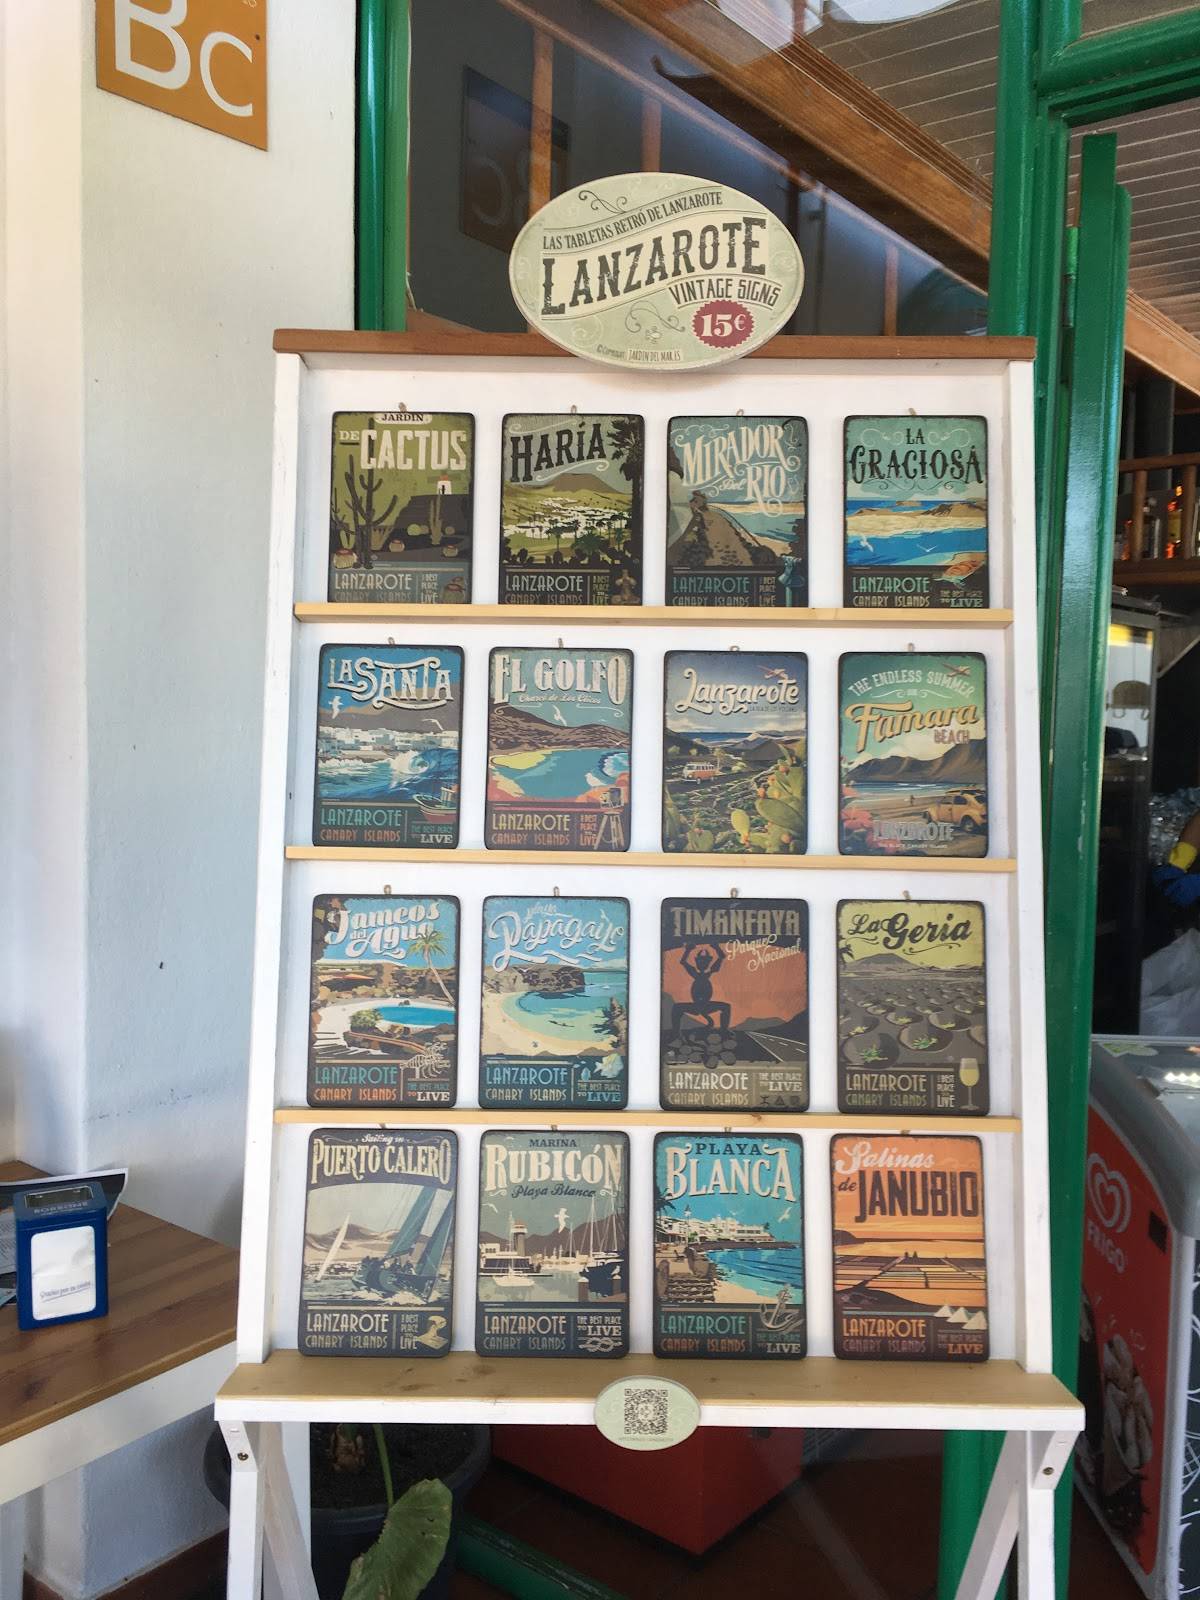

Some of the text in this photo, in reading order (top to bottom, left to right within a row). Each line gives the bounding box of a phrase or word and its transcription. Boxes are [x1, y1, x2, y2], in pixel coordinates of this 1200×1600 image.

[543, 191, 723, 250] LAS TABLETAS RETRÓ DE LANZAROTE
[541, 216, 768, 316] LANZAROTE
[668, 277, 782, 305] VINTAGE SIGNS
[700, 312, 747, 338] 15€
[381, 413, 424, 422] JARDIN
[906, 428, 926, 444] LA
[339, 429, 467, 470] DE CACTUS
[510, 421, 607, 483] HARÍA
[675, 424, 801, 486] MIRADOR
[335, 574, 413, 590] LANZAROTE
[505, 575, 583, 591] LANZAROTE
[673, 577, 750, 593] LANZAROTE
[852, 577, 930, 593] LANZAROTE
[853, 595, 889, 606] CANARY
[895, 596, 930, 607] ISLANDS
[950, 598, 983, 607] LIVE
[328, 656, 454, 710] LA SANTA
[494, 654, 627, 705] EL GOLFO
[848, 669, 975, 698] THE ENDLESS SUMMER
[675, 668, 800, 715] Lanzarote
[845, 700, 980, 753] Famara
[934, 729, 970, 745] BEACH
[320, 808, 402, 826] LANZAROTE
[492, 814, 571, 831] LANZAROTE
[320, 829, 401, 842] CANARY ISLANDS
[420, 834, 453, 843] LIVE
[492, 833, 570, 846] CANARY ISLANDS
[324, 902, 441, 945] Jameos
[848, 912, 973, 950] La Geria
[346, 923, 436, 959] Agua
[488, 911, 624, 972] Papagayo
[725, 934, 777, 961] Parque
[748, 937, 801, 971] Nacional
[315, 1066, 398, 1085] LANZAROTE
[486, 1067, 568, 1085] LANZAROTE
[668, 1072, 749, 1090] LANZAROTE
[846, 1074, 927, 1091] LANZAROTE
[313, 1088, 397, 1101] CANARY ISLANDS
[485, 1088, 567, 1101] CANARY ISLANDS
[768, 1082, 802, 1091] LIVE
[417, 1092, 450, 1101] LIVE
[587, 1092, 621, 1102] LIVE
[668, 1092, 748, 1105] CANARY ISLANDS
[846, 1094, 927, 1107] CANARY ISLANDS
[937, 1095, 955, 1108] LIVE
[361, 1133, 393, 1145] Sailing
[529, 1138, 577, 1148] MARINA
[695, 1143, 763, 1156] PLAYA
[834, 1141, 935, 1175] Salinas
[310, 1138, 451, 1185] PUERTO CALERO
[484, 1144, 624, 1192] RUBICÓN
[664, 1143, 797, 1203] BLANCA
[511, 1183, 597, 1200] Playa Blanca
[838, 1169, 980, 1223] de JANUBIO
[306, 1313, 389, 1333] LANZAROTE
[484, 1315, 567, 1335] LANZAROTE
[587, 1325, 622, 1336] LIVE
[660, 1315, 746, 1335] LANZAROTE
[842, 1318, 927, 1338] LANZAROTE
[305, 1335, 344, 1348] CANARY
[350, 1335, 388, 1349] ISLANDS
[400, 1336, 418, 1349] LIVE
[483, 1336, 566, 1350] CANARY ISLANDS
[661, 1337, 746, 1352] CANARY ISLANDS
[766, 1343, 801, 1353] LIVE
[948, 1344, 984, 1354] LIVE
